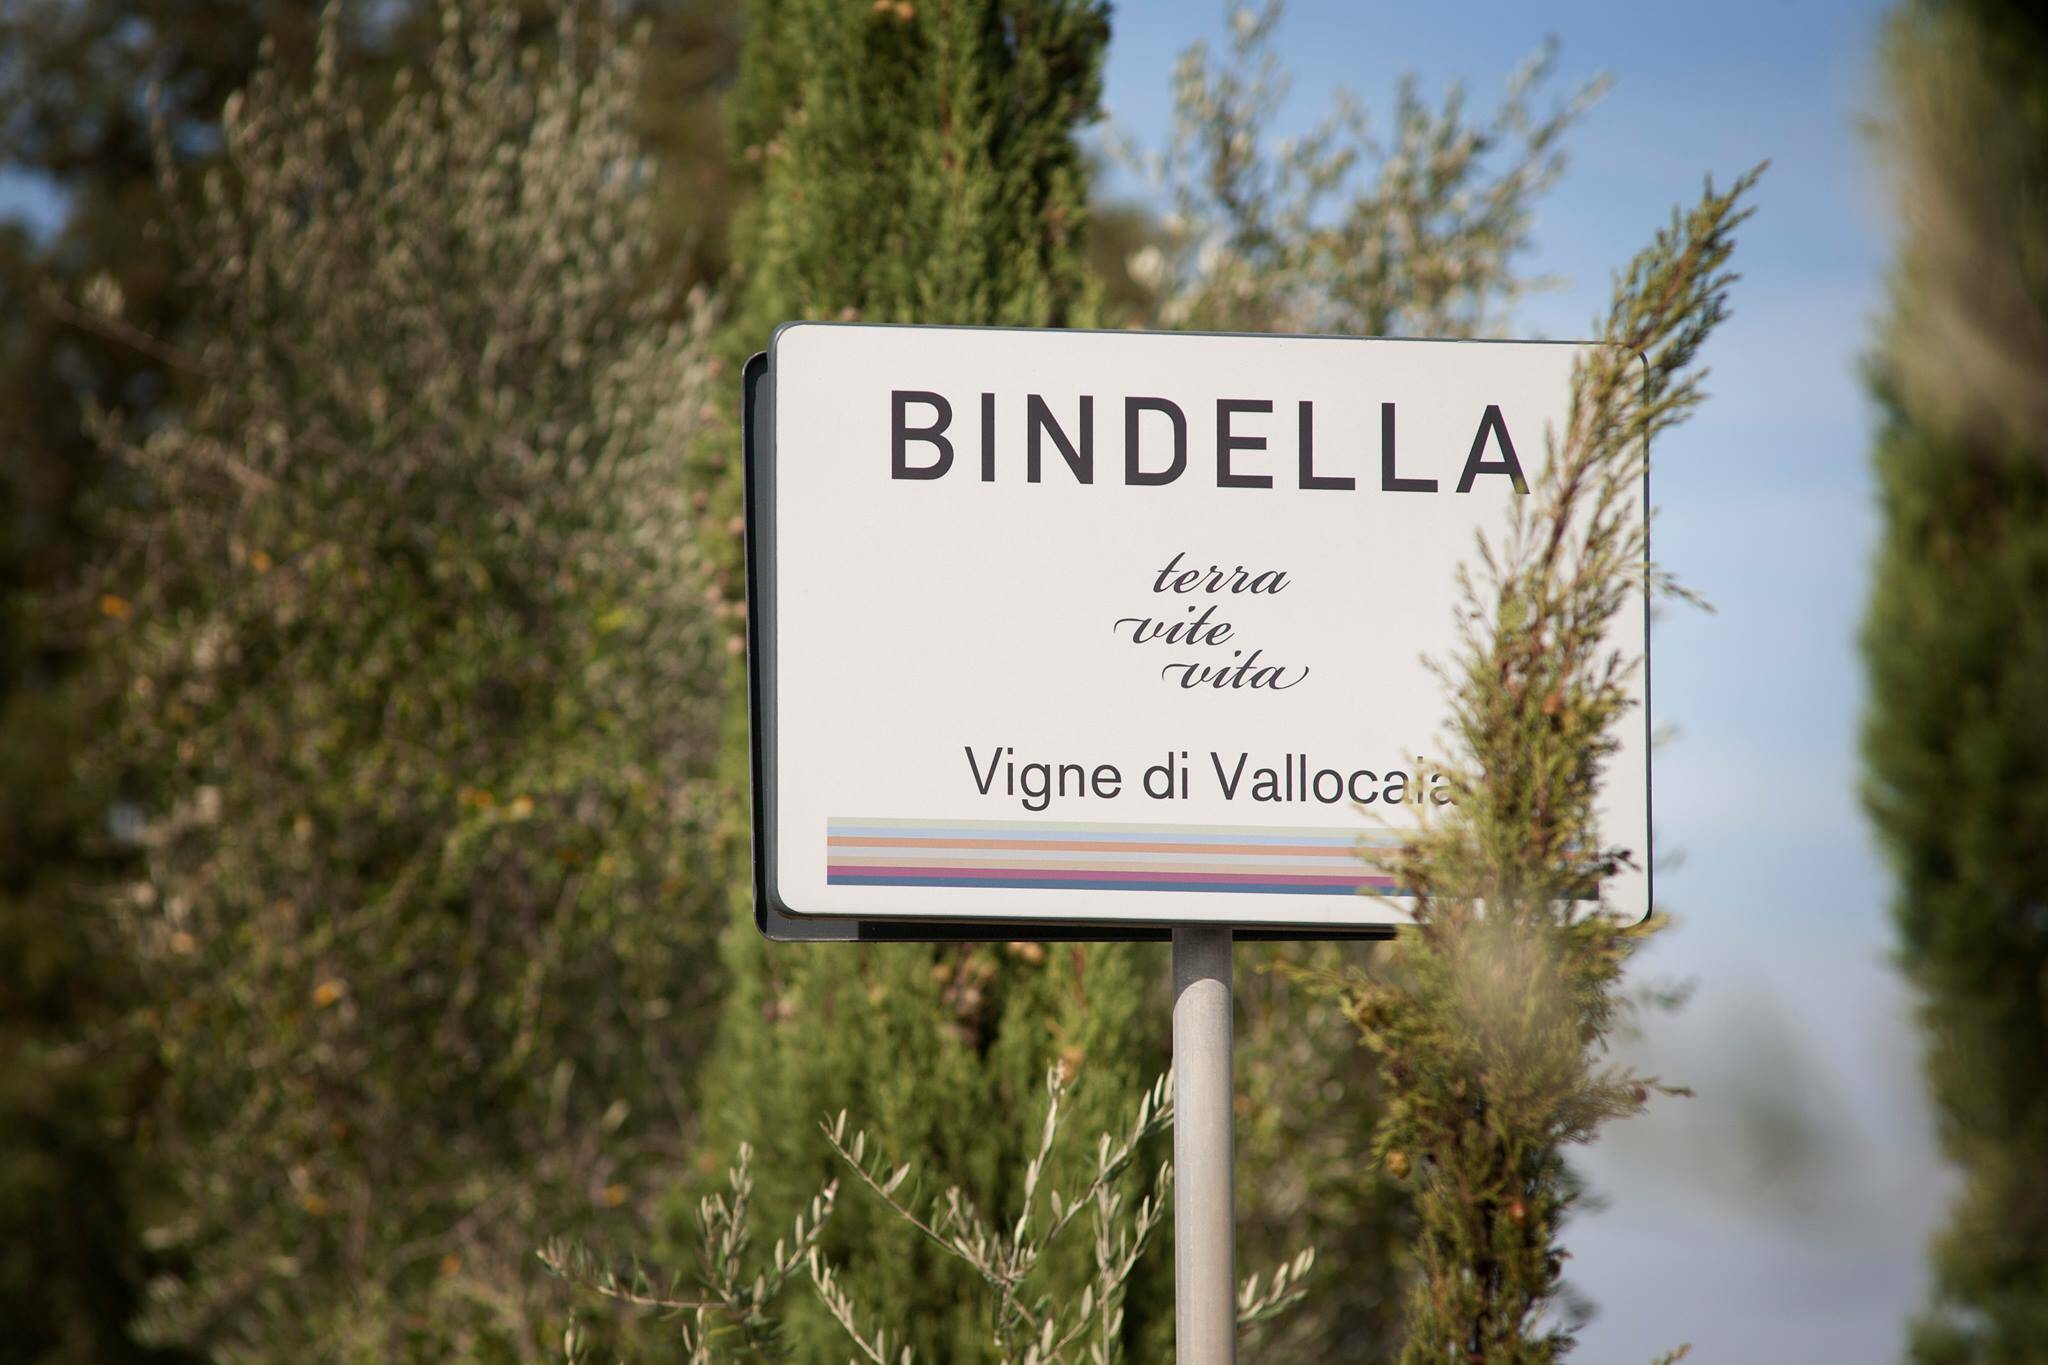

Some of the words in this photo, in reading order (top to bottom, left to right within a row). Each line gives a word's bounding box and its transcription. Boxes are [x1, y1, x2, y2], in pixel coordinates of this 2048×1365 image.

[891, 390, 1530, 495] BINDELLA
[1152, 551, 1291, 595] terra
[1113, 604, 1235, 646] vite
[1161, 649, 1310, 690] vita
[964, 746, 1122, 812] Vigne
[1143, 751, 1188, 800] di
